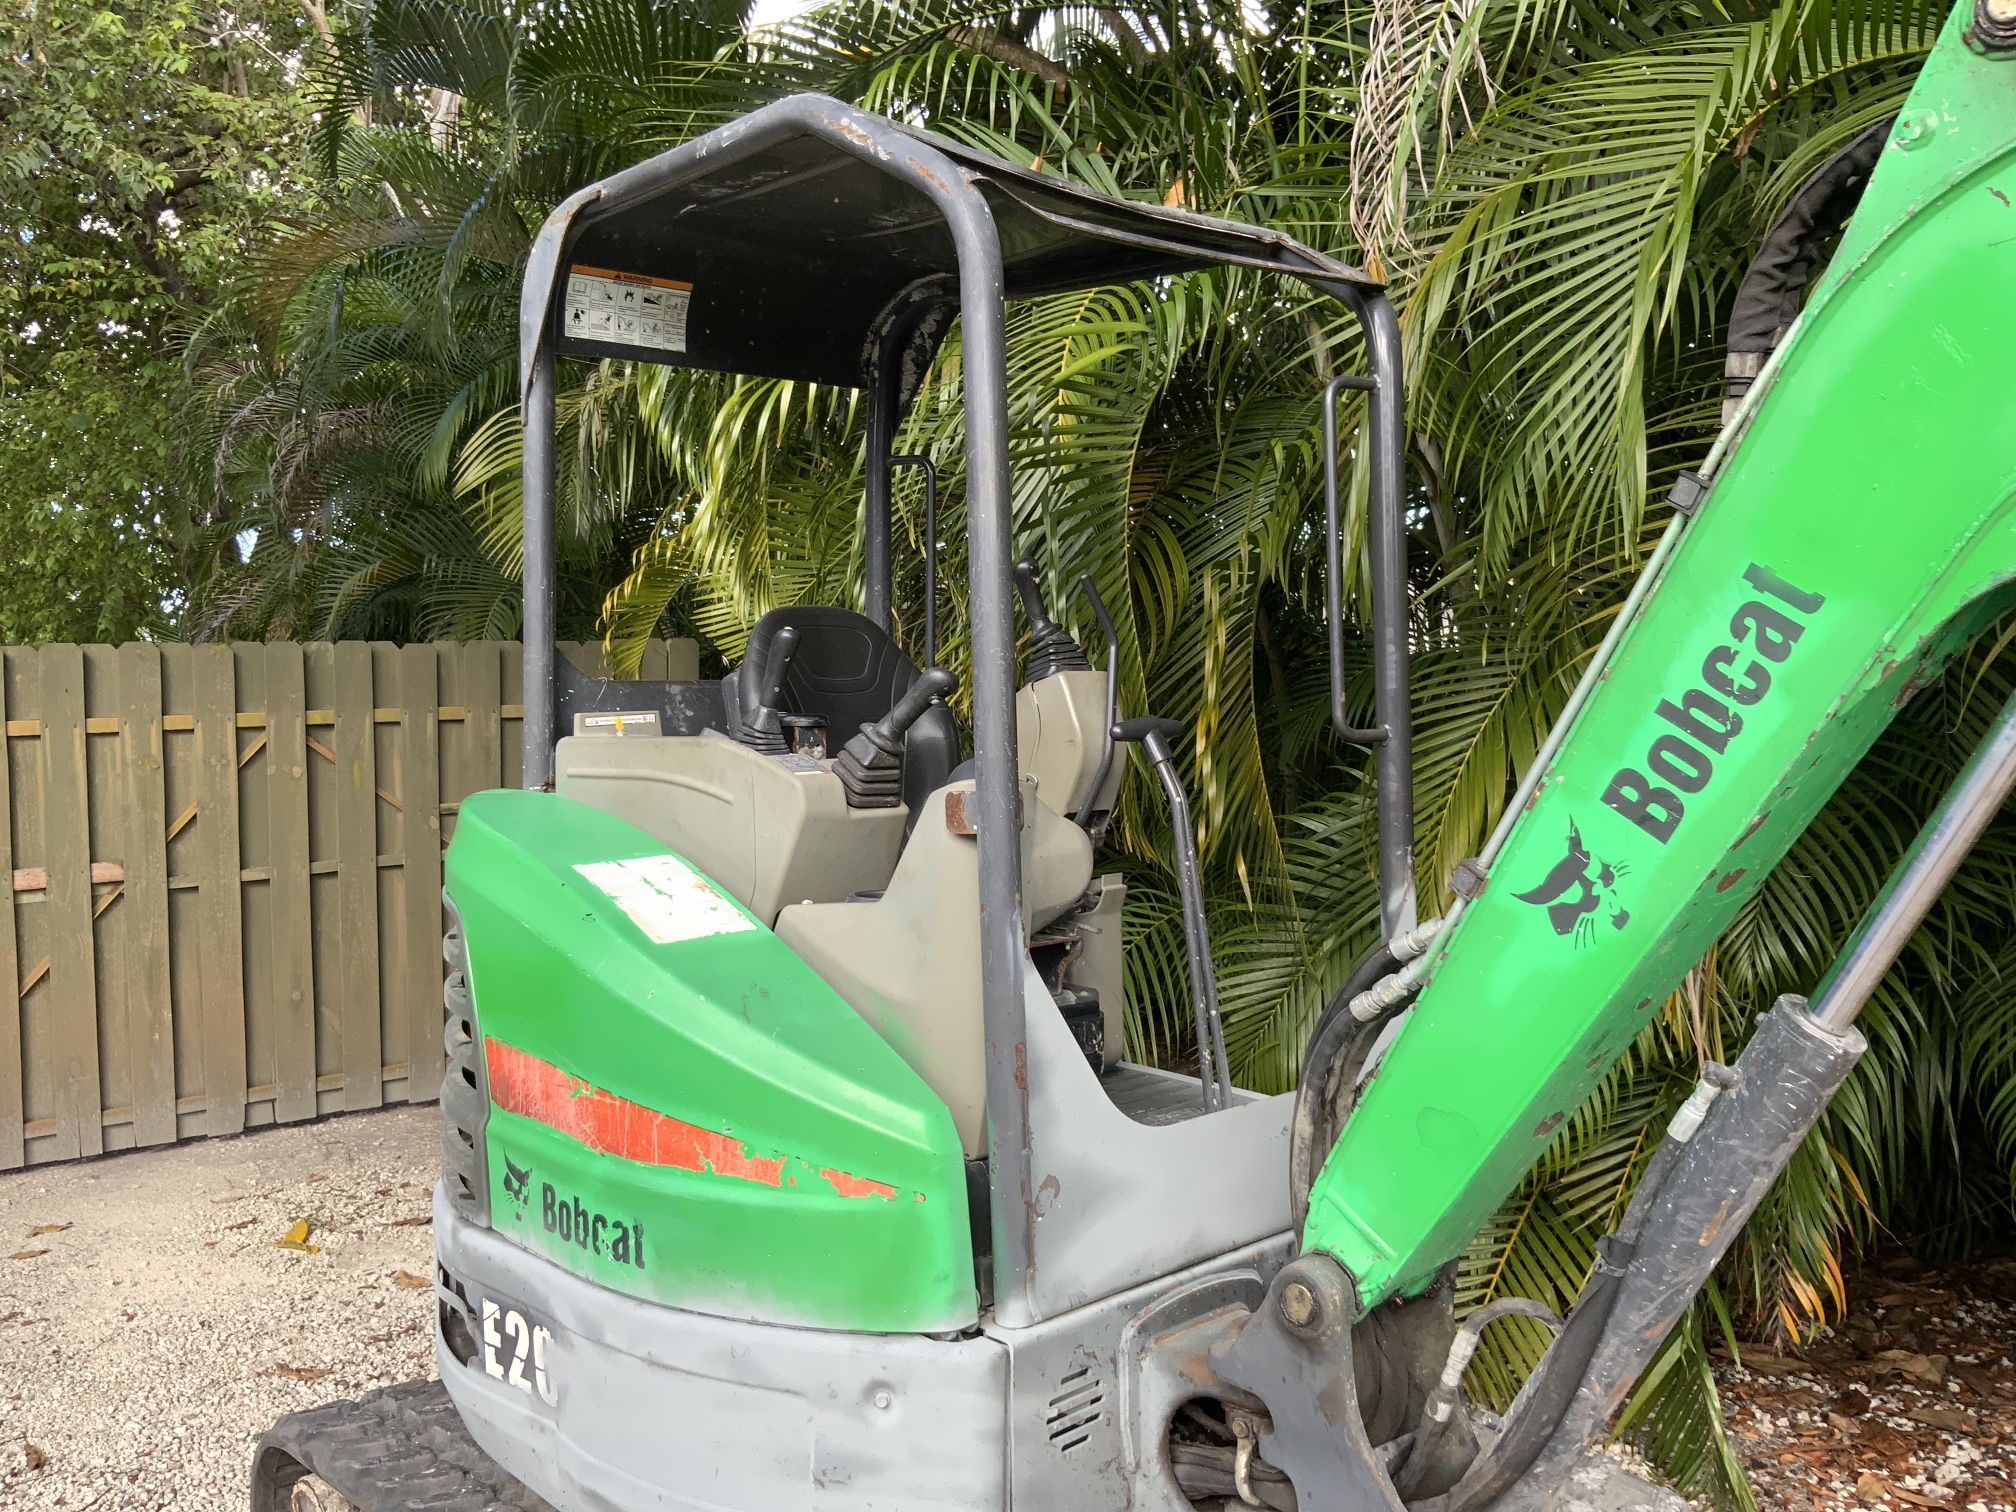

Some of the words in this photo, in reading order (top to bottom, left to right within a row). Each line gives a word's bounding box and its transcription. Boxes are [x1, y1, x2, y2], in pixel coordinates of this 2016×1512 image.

[623, 273, 653, 284] WARNING
[1599, 561, 1826, 845] Bobcat
[542, 1182, 646, 1270] Bobcat
